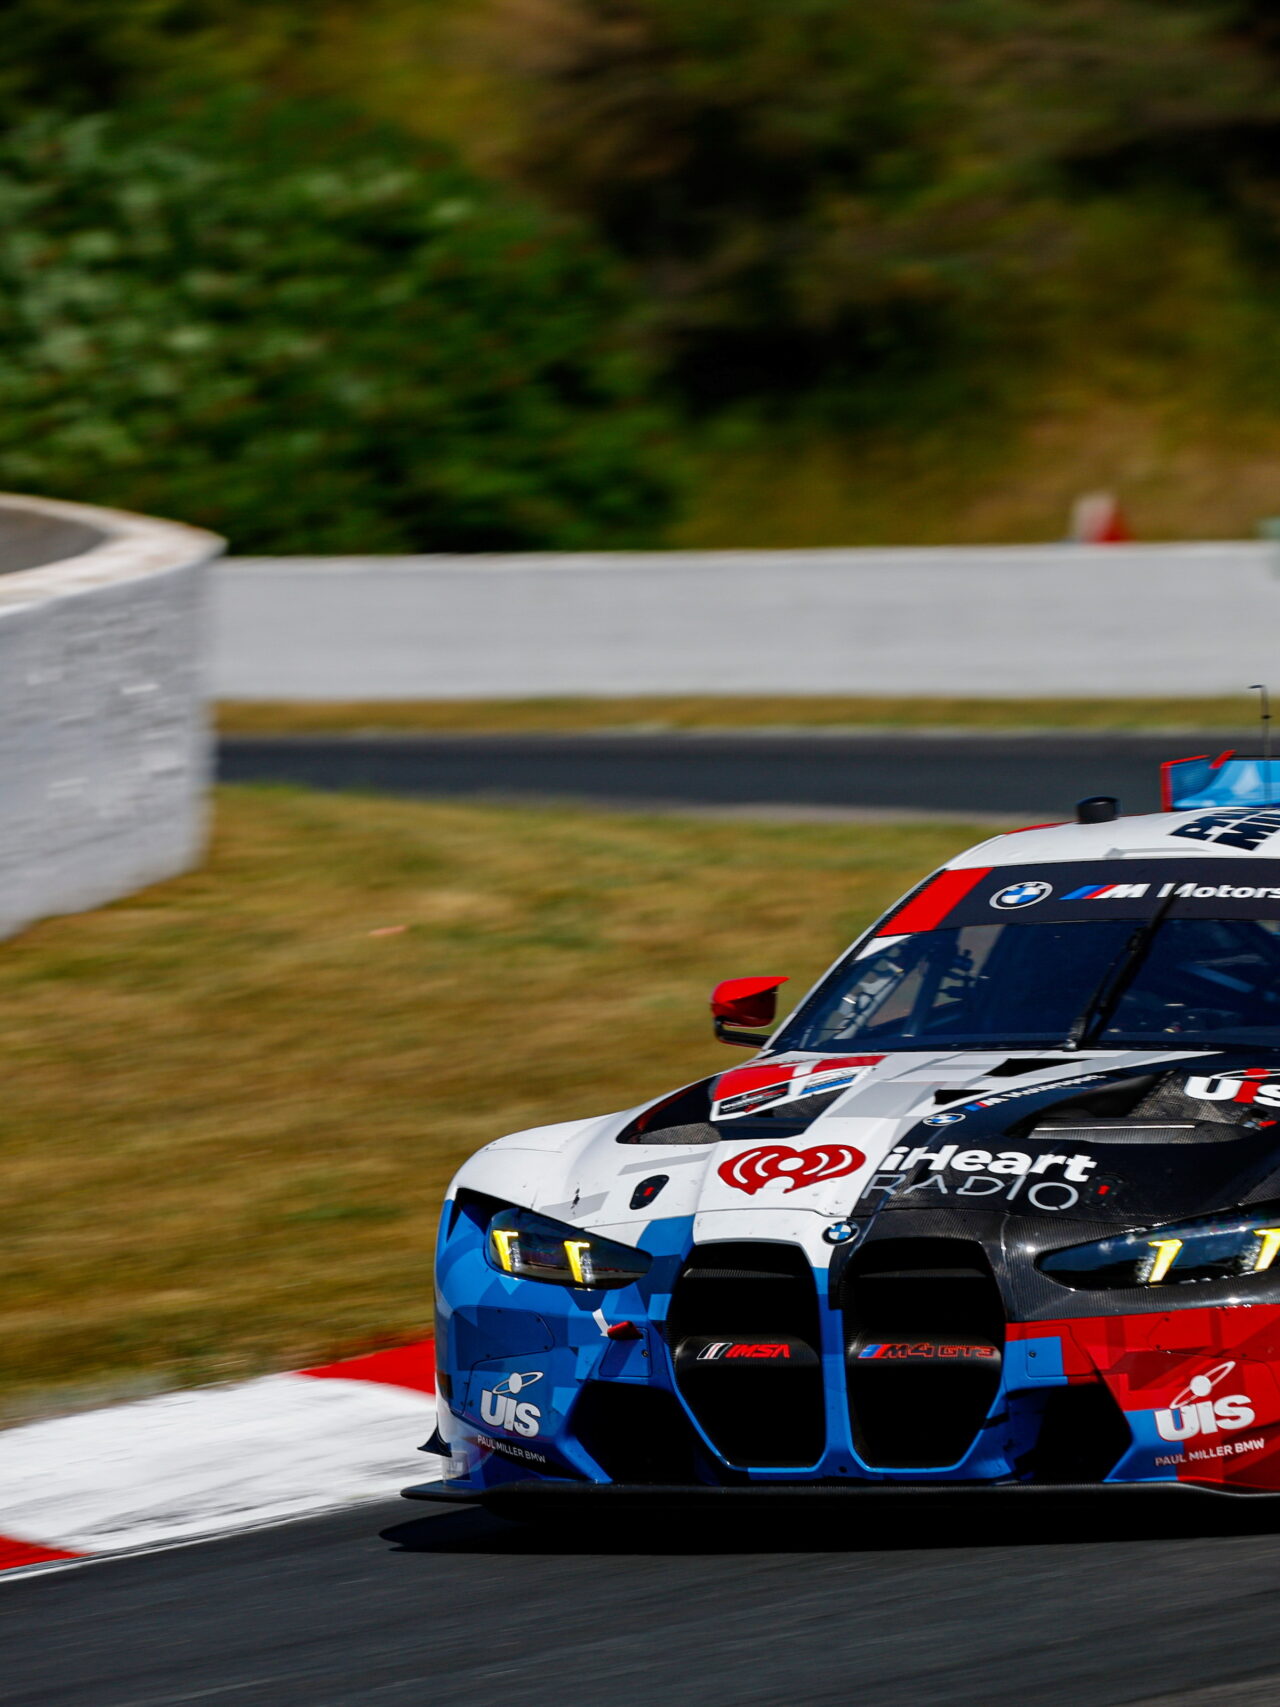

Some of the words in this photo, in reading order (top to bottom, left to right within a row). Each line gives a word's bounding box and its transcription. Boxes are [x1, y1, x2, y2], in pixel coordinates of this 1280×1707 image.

[879, 1145, 1097, 1182] iHeart
[861, 1173, 1079, 1211] RADIO
[725, 1343, 790, 1358] IMSA
[477, 1434, 496, 1449] PAUL
[496, 1442, 524, 1457] MILLER
[525, 1450, 546, 1463] BMW
[1154, 1454, 1187, 1467] PAUL
[1188, 1444, 1233, 1461] MILLER
[1234, 1437, 1265, 1453] BMW
